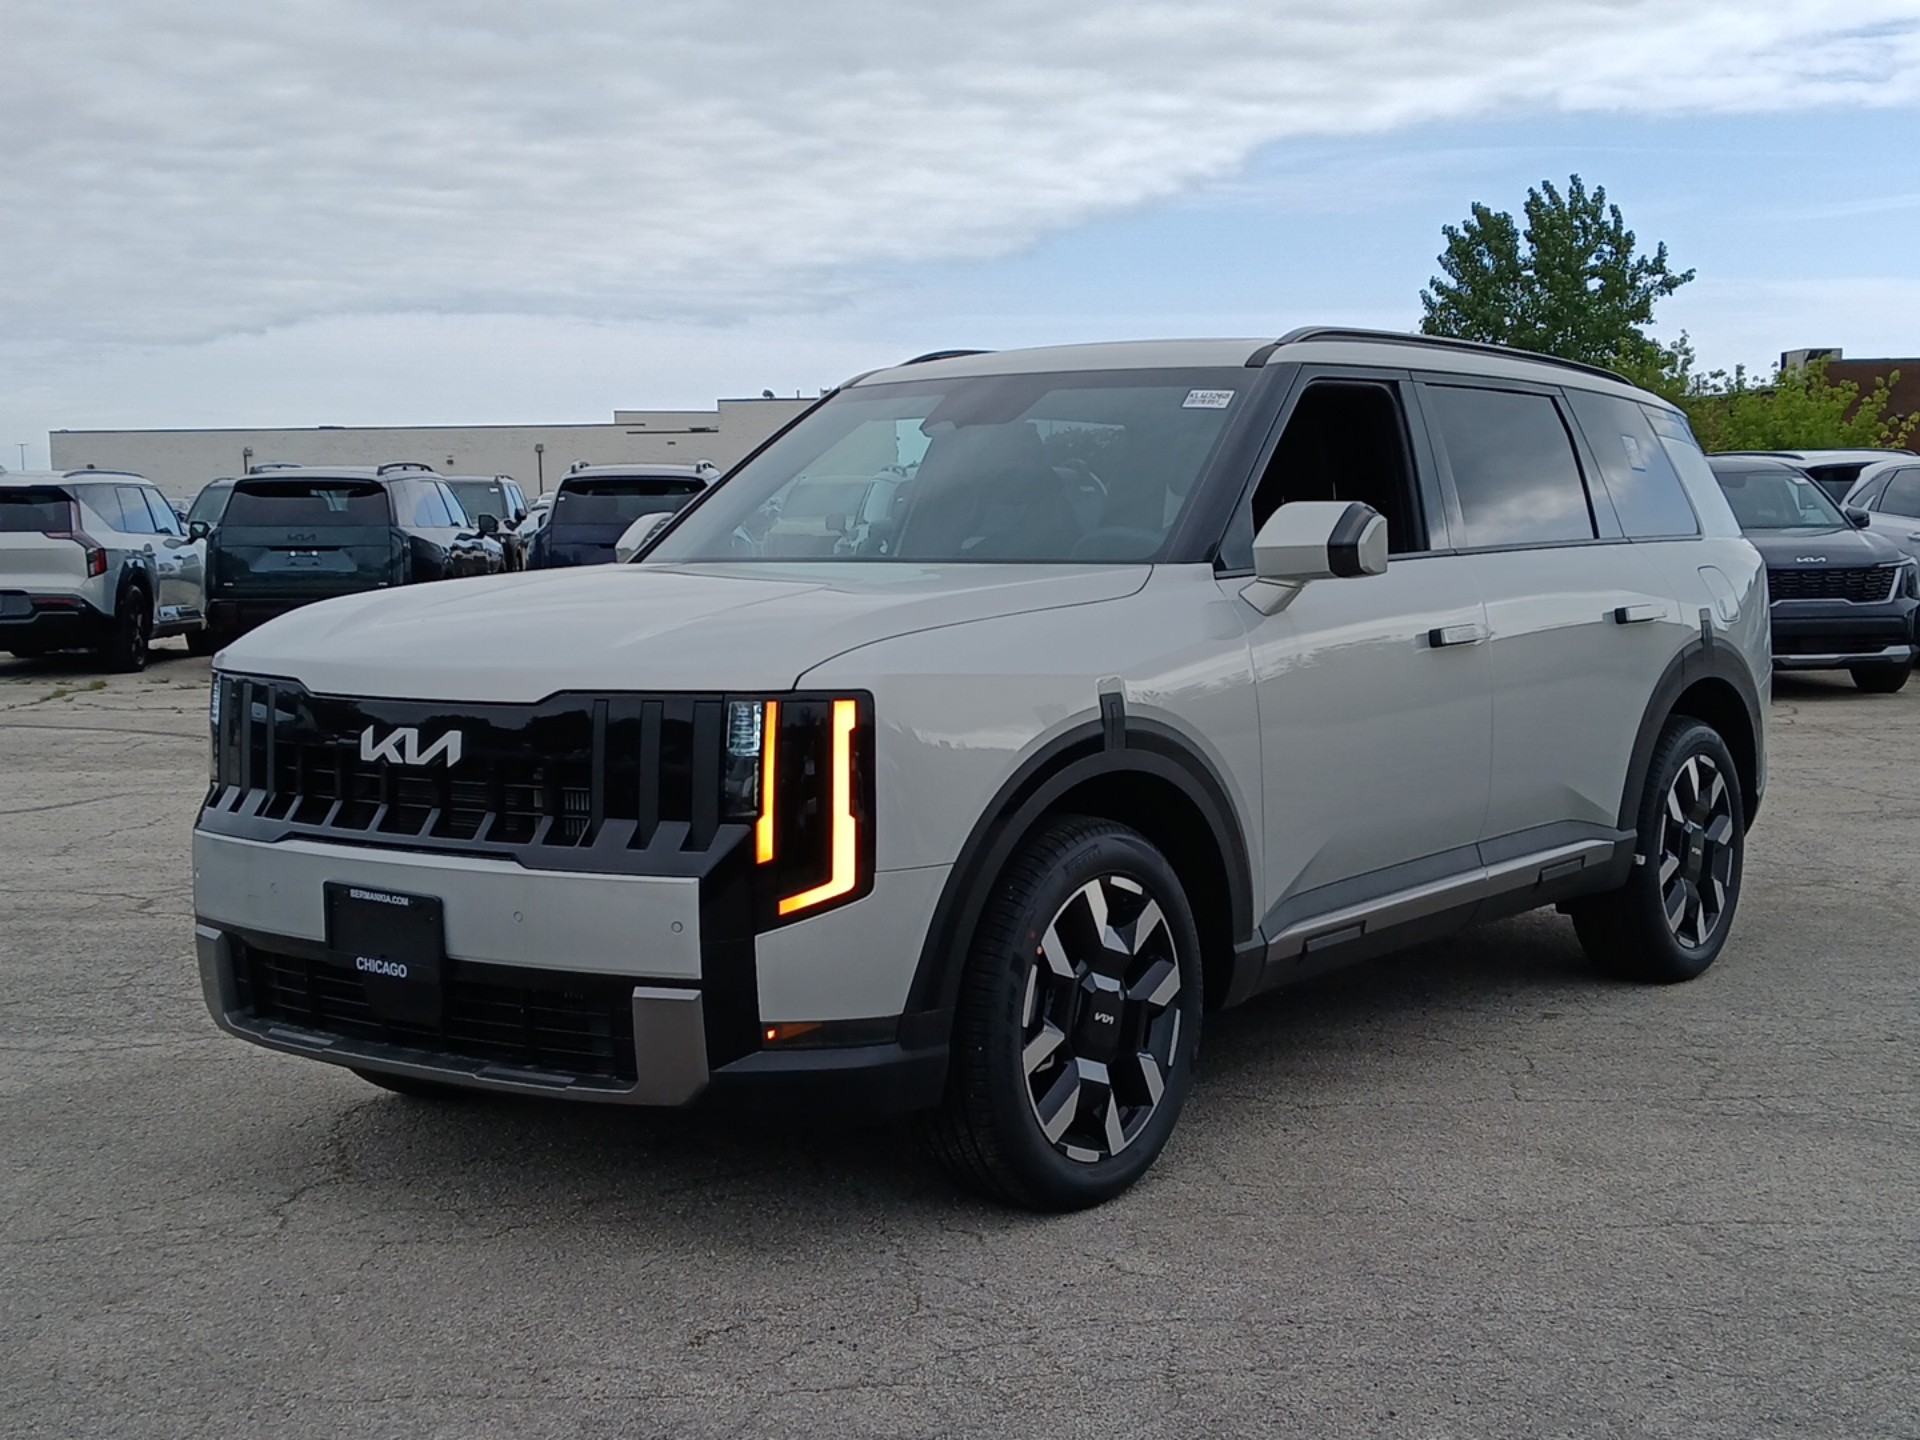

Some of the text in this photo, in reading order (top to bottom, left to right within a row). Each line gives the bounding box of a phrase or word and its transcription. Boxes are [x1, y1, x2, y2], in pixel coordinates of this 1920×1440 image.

[361, 724, 462, 768] KIA
[350, 888, 409, 906] BERMANKIA.COM
[356, 957, 408, 978] CHICAGO
